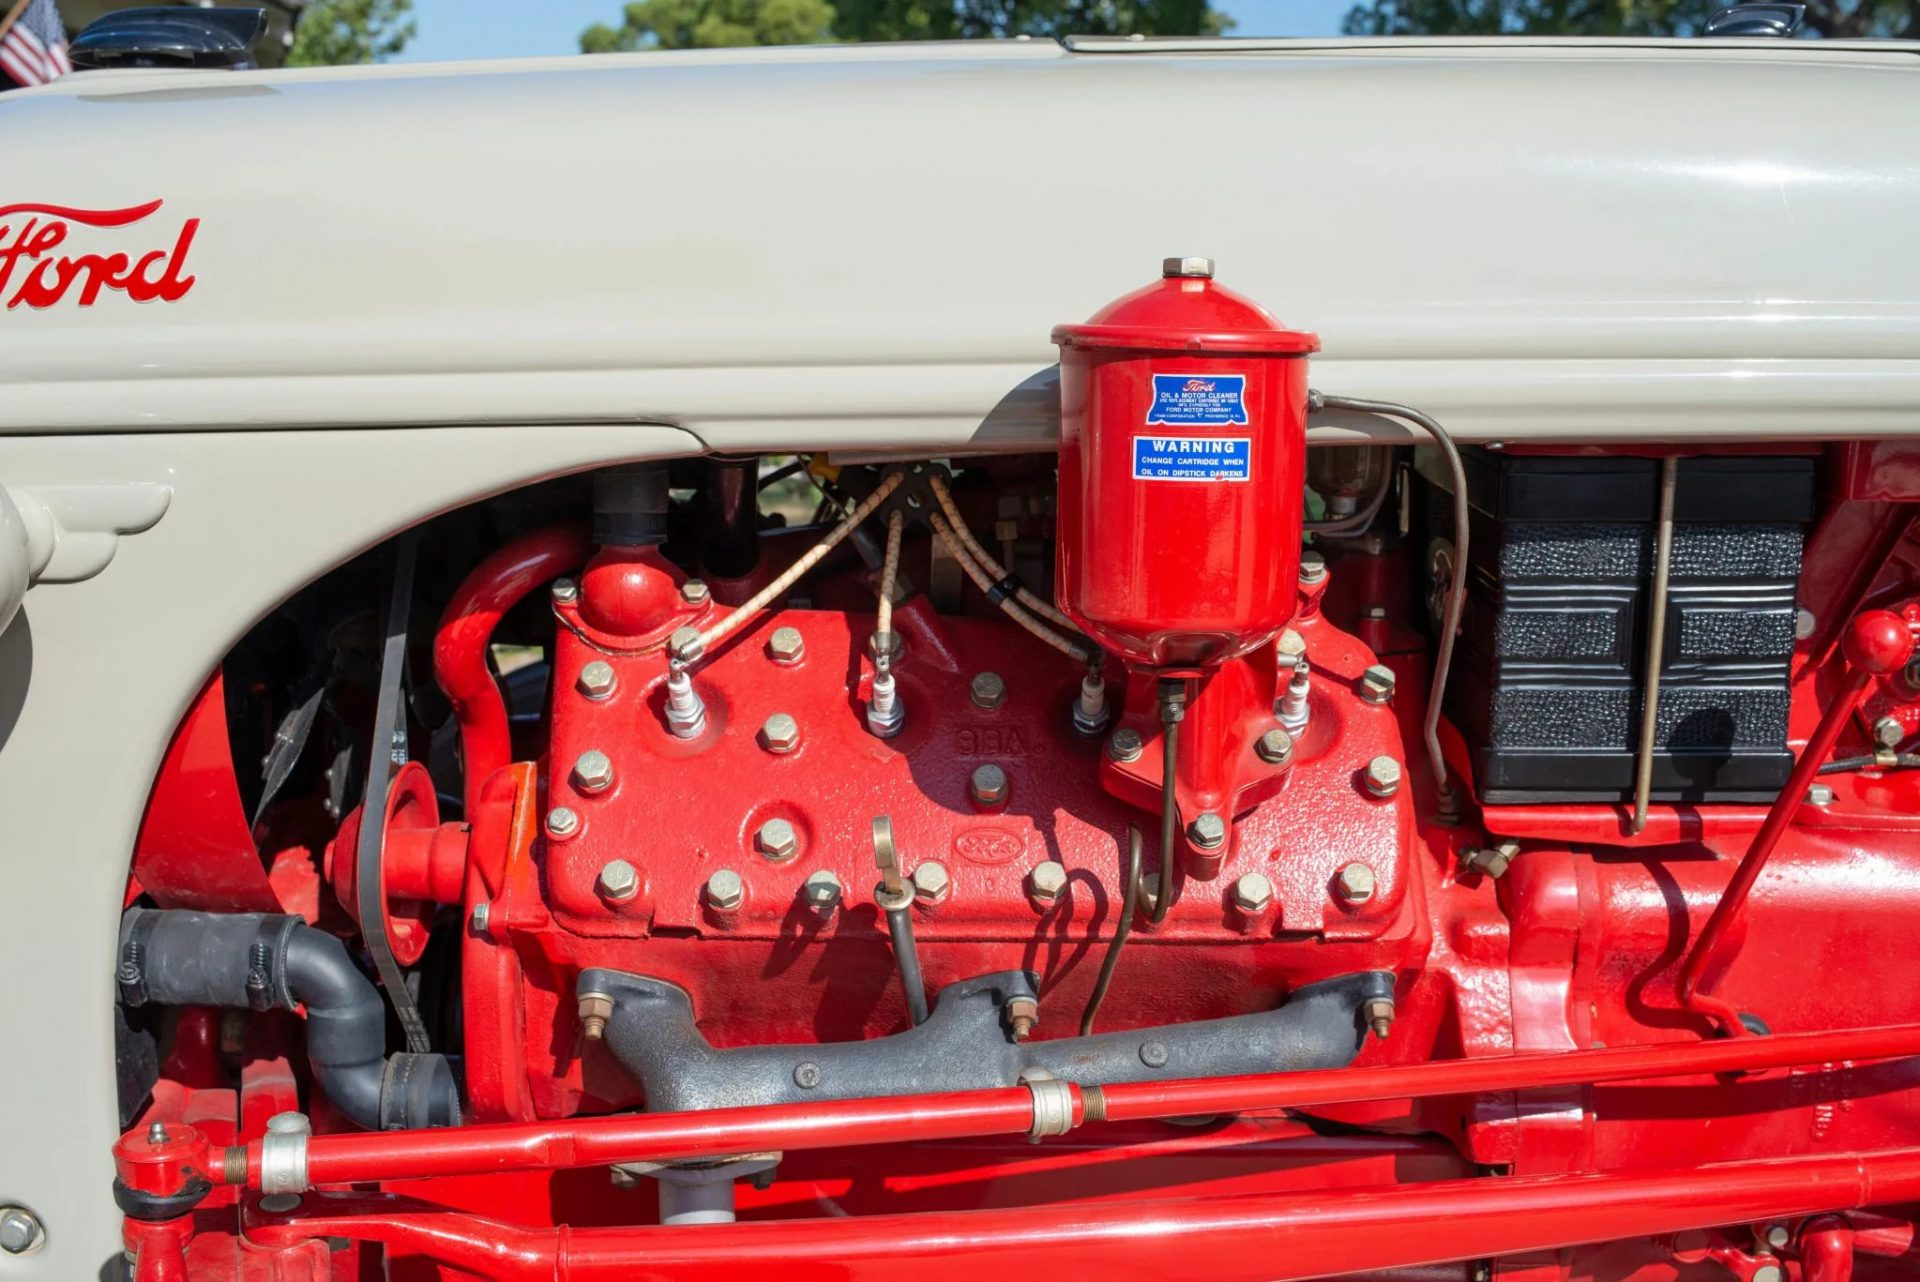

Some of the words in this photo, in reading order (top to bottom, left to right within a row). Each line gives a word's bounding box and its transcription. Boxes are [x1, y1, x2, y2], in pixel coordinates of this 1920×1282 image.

[1182, 379, 1216, 392] Ford
[1152, 439, 1235, 454] WARNING
[1141, 456, 1173, 464] CHANGE
[1177, 457, 1220, 465] CARTRIDGE
[1222, 458, 1244, 466] WHEN
[1141, 468, 1153, 476] OIL
[1172, 469, 1206, 477] DIPSTICK
